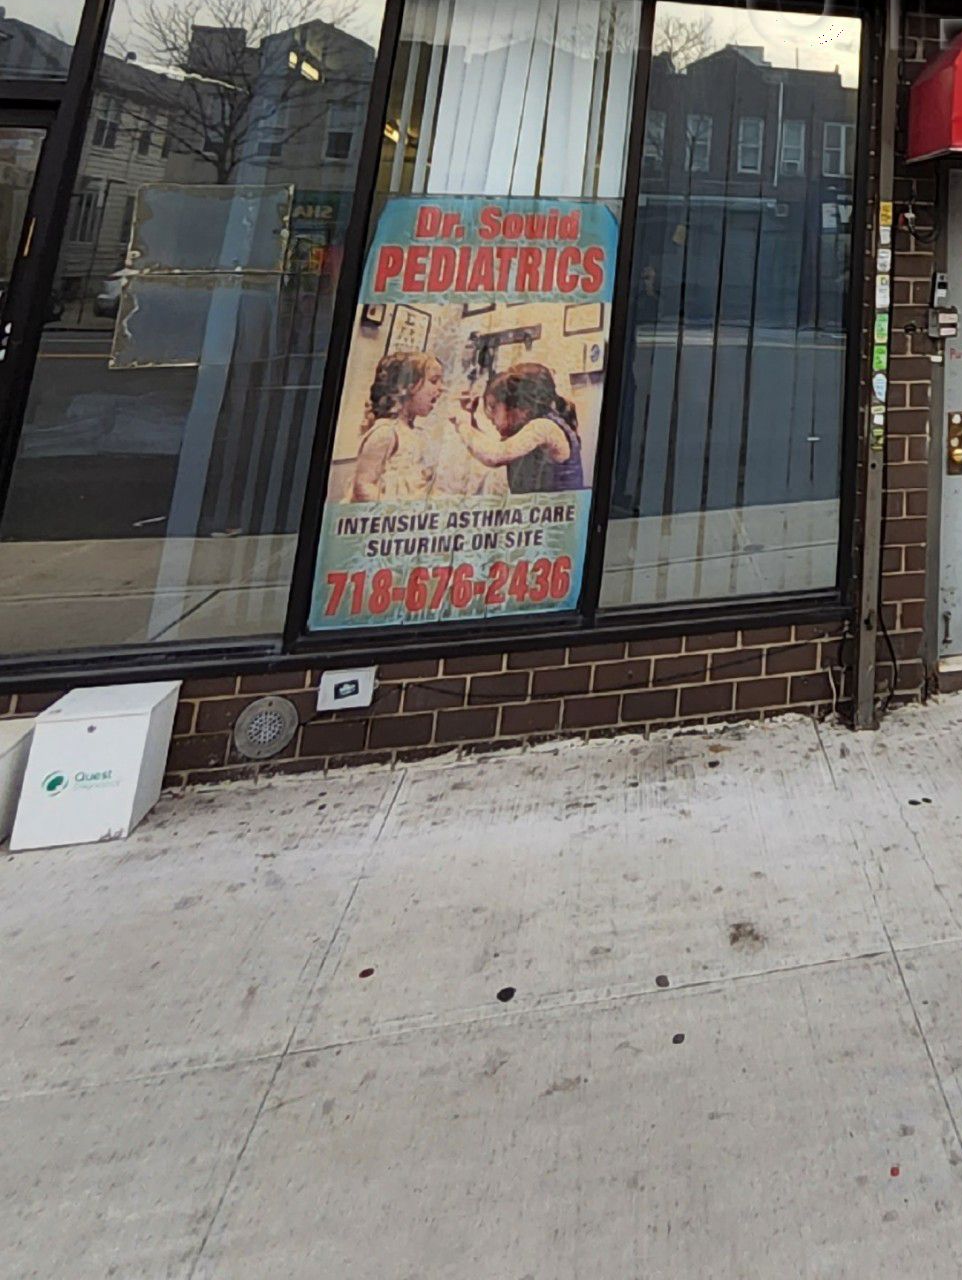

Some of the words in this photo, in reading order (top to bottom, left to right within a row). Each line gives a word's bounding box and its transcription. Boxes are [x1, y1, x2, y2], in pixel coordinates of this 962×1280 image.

[415, 206, 464, 240] Dr.
[478, 205, 581, 241] Souid
[374, 245, 606, 294] PEDIATRICS
[337, 511, 440, 536] INTENSIVE
[446, 507, 523, 529] ASTHMA
[529, 505, 576, 525] CARE
[366, 534, 465, 558] SUTURING
[471, 533, 498, 551] ON
[505, 529, 544, 548] SITE
[325, 556, 572, 617] 718-676-2436
[75, 769, 113, 783] Quest
